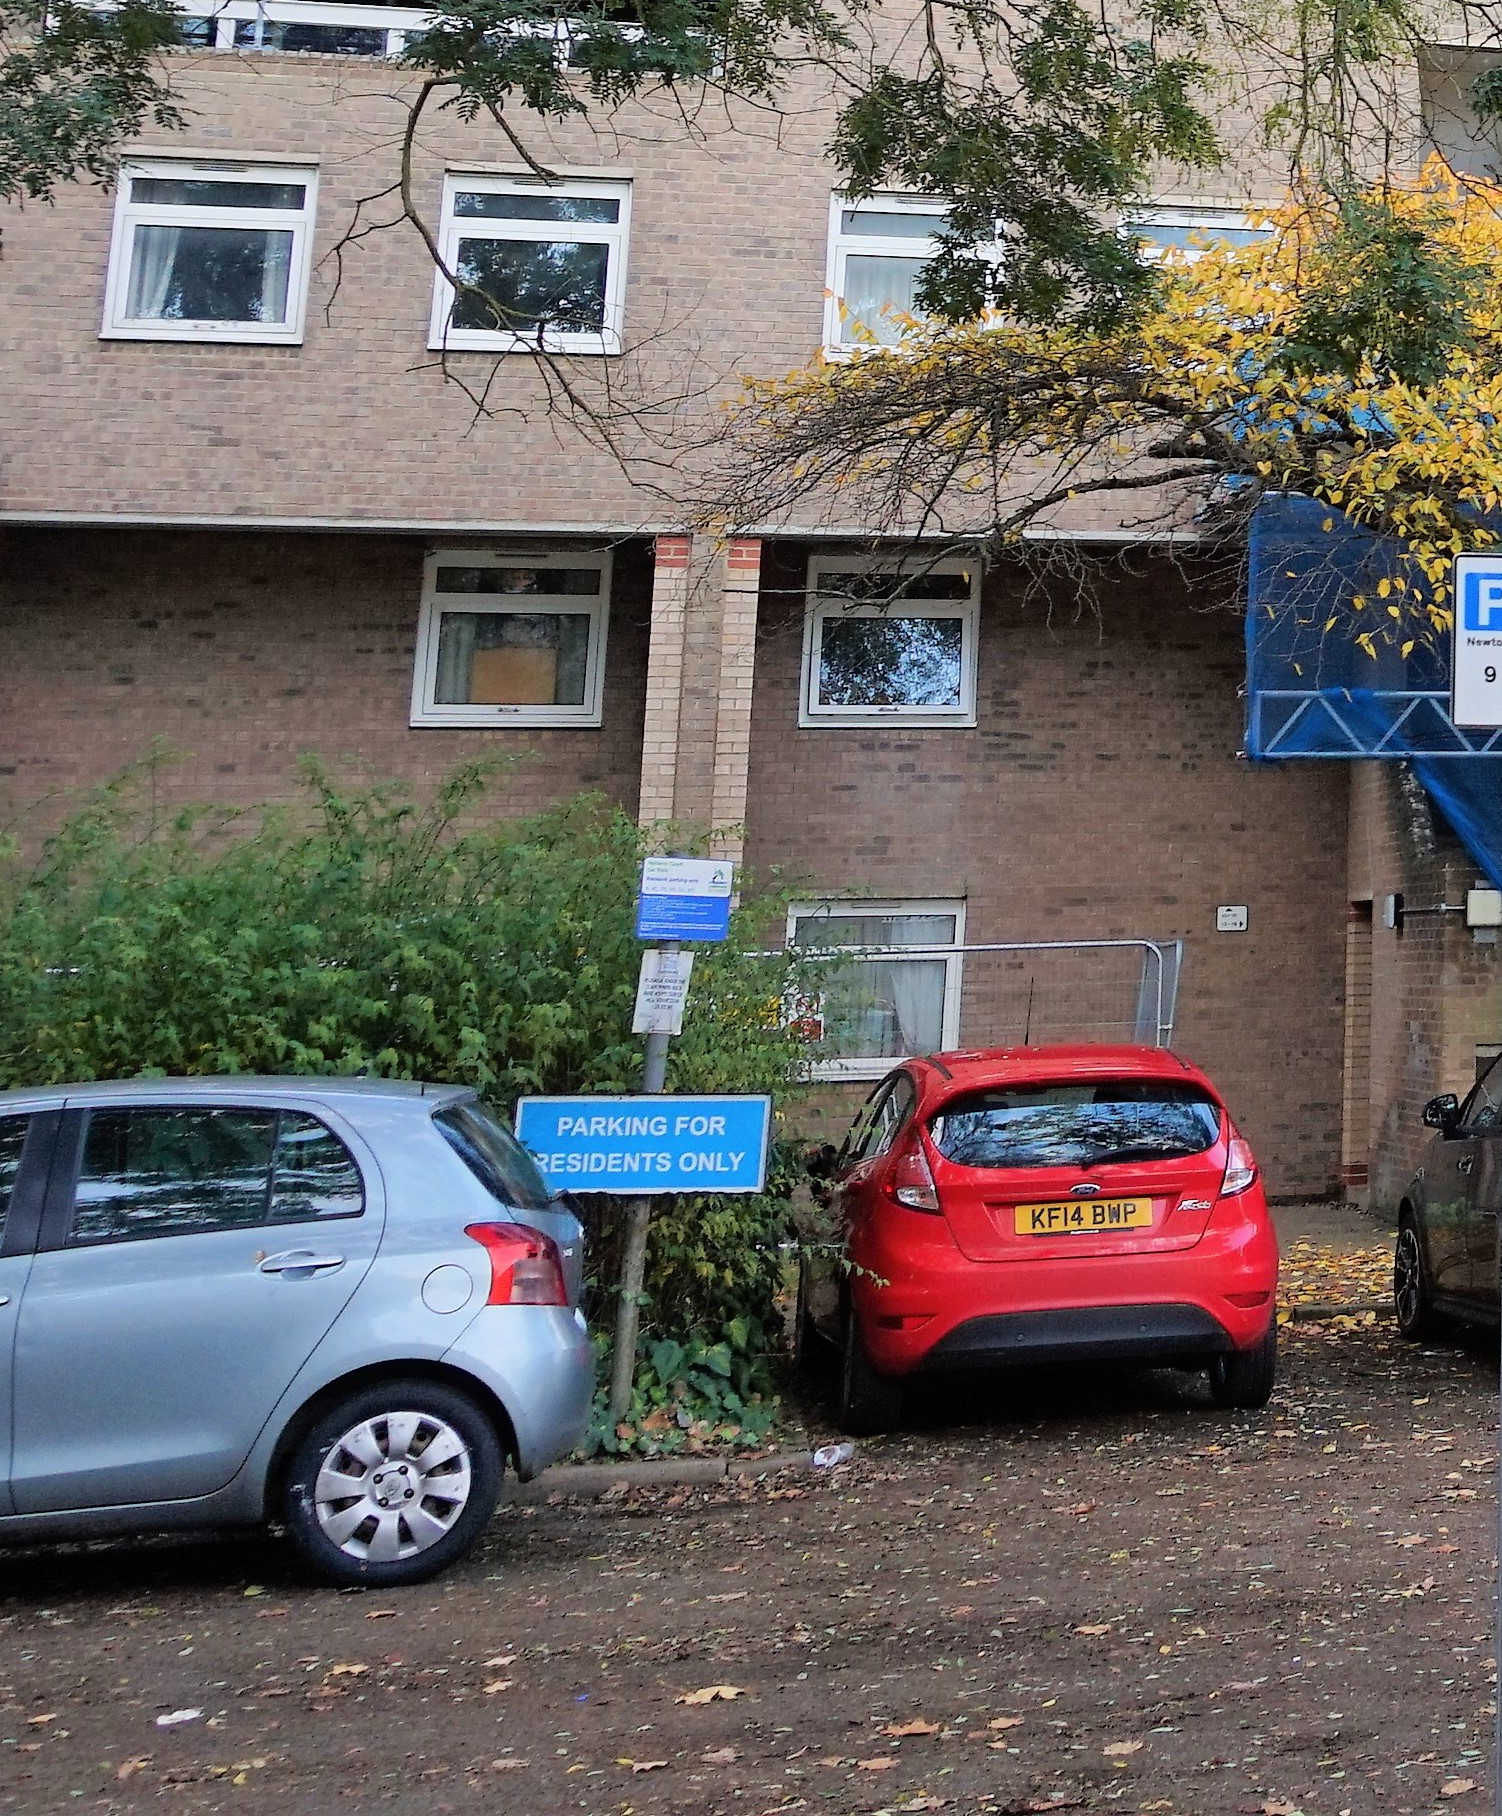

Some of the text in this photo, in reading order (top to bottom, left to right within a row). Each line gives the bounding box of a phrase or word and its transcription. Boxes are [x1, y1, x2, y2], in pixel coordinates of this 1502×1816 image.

[1484, 666, 1497, 683] 9
[556, 1116, 726, 1137] PARKING FOR
[534, 1151, 745, 1174] RESIDENTS ONLY
[1031, 1202, 1137, 1230] KF14 BWP
